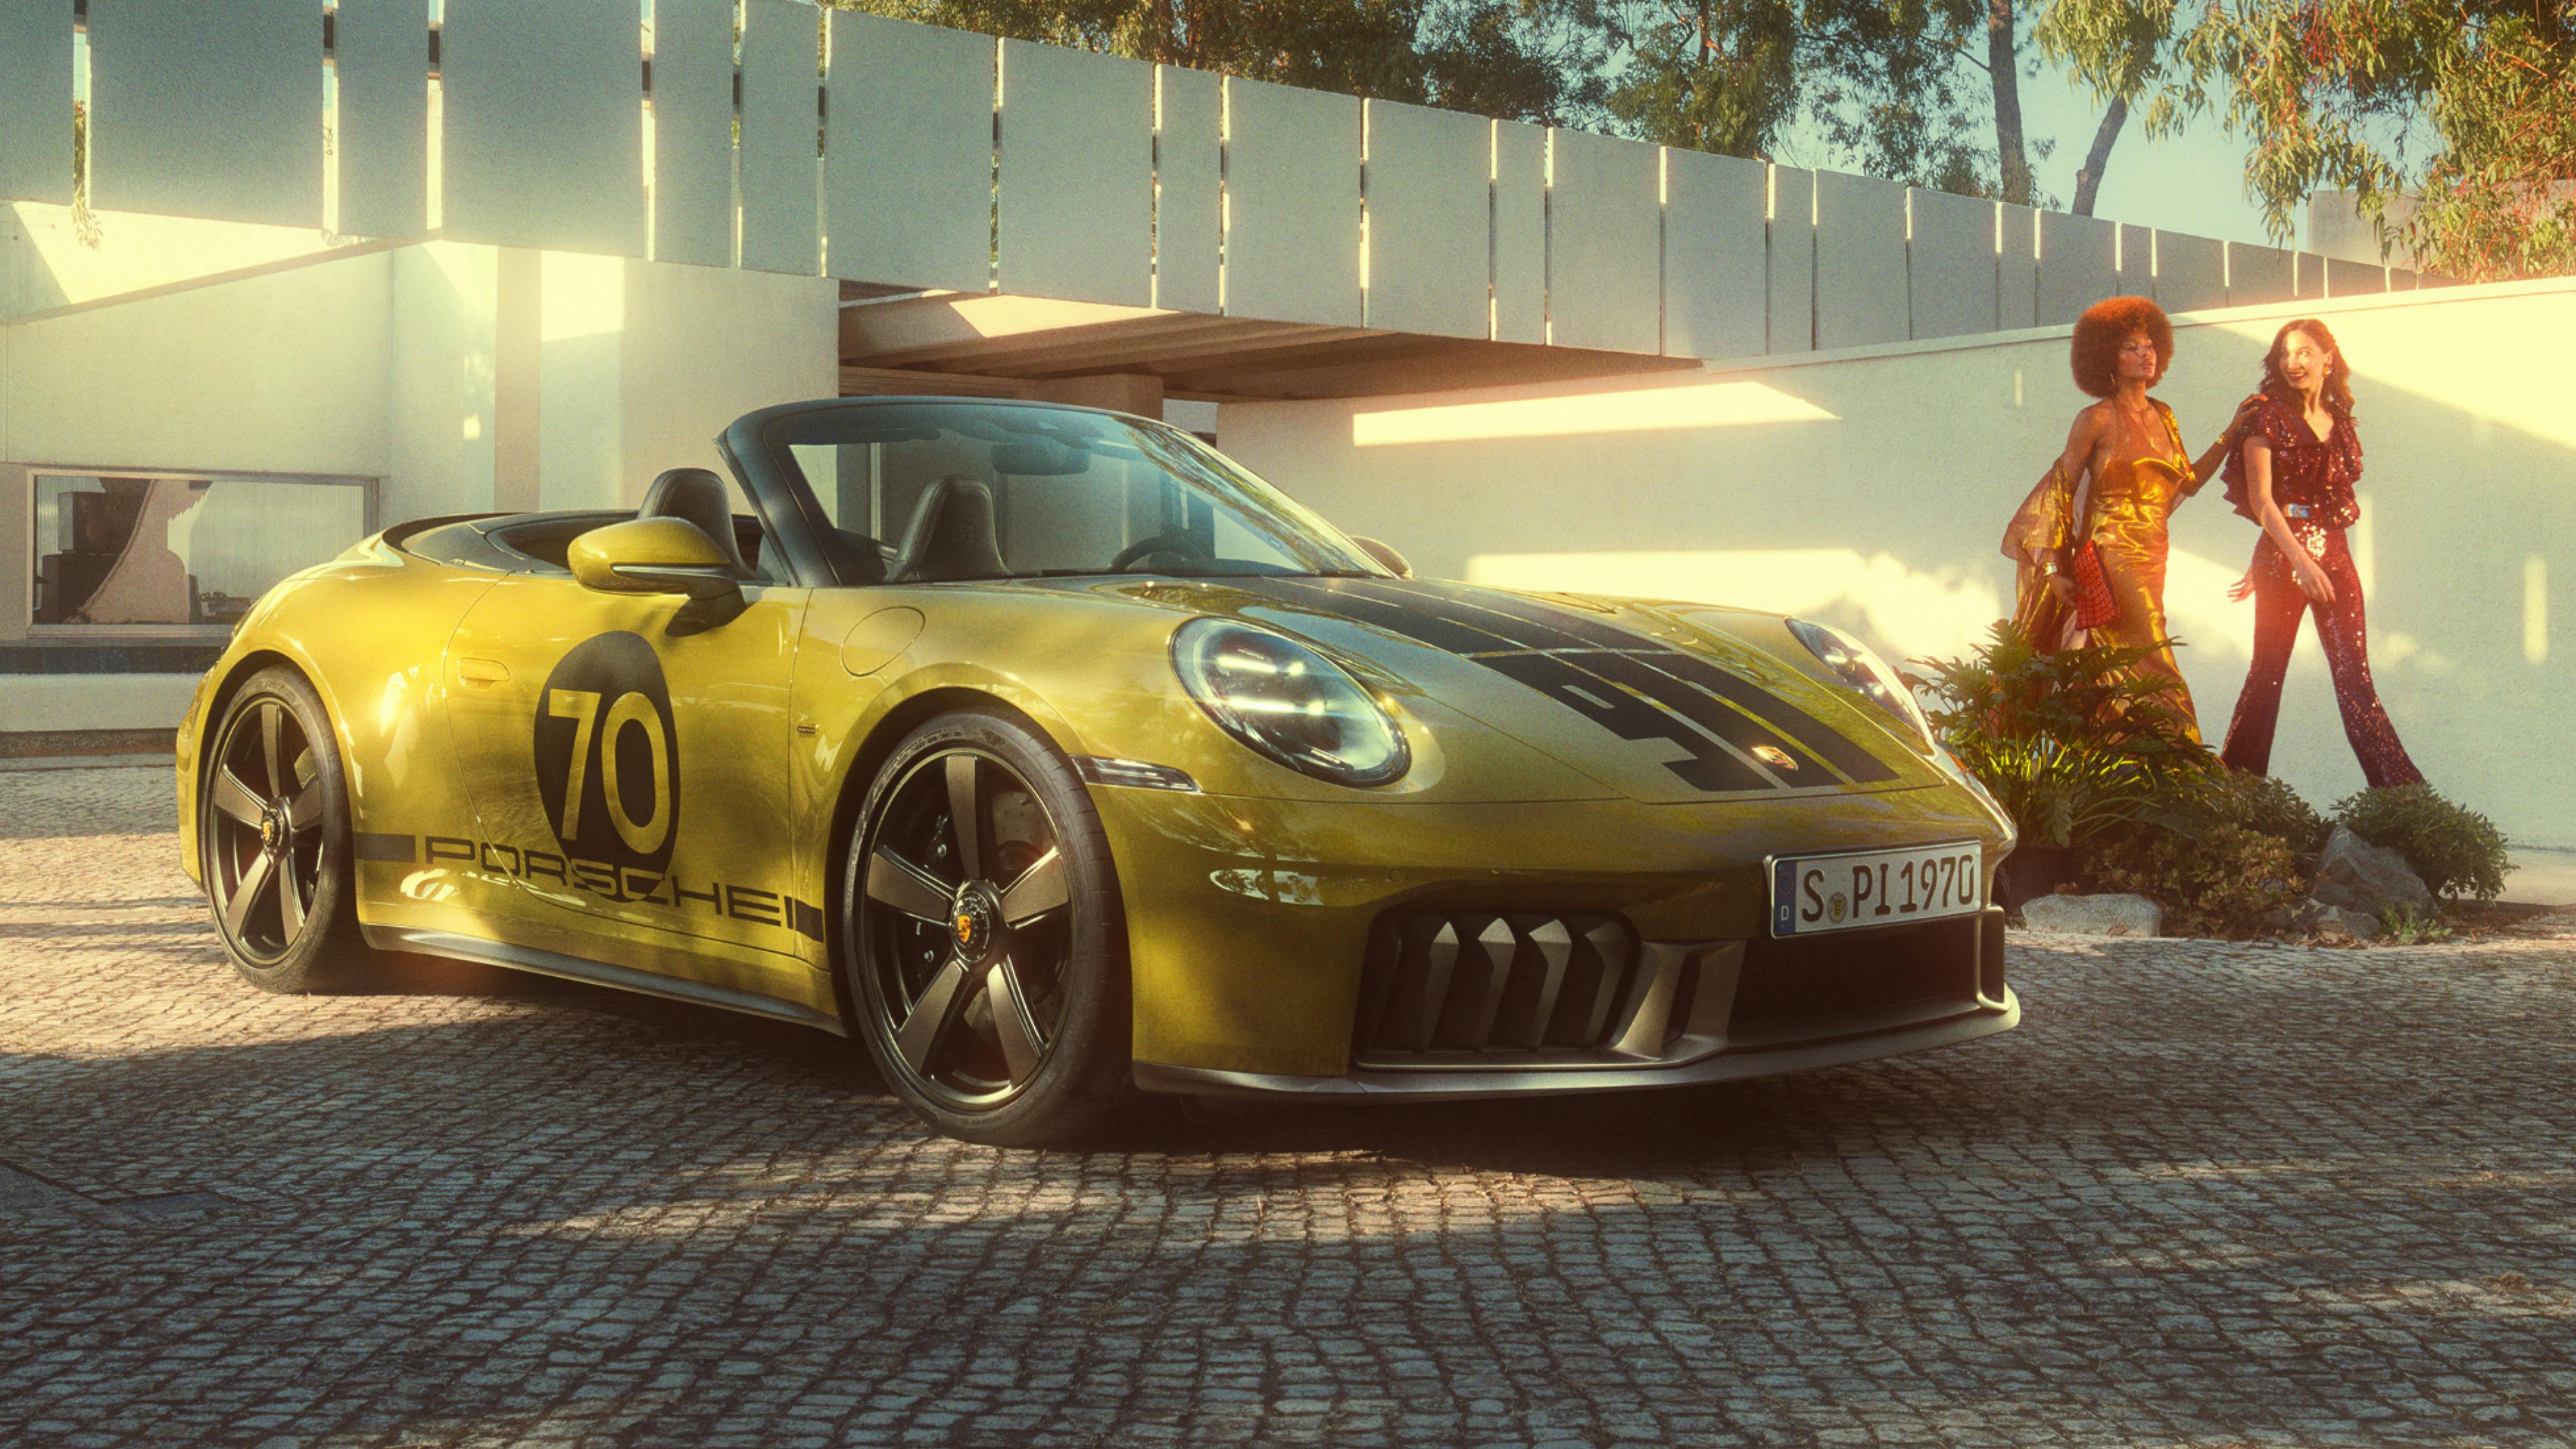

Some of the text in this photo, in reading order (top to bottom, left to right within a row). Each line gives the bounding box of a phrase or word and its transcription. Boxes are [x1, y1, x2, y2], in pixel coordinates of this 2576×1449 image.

[548, 688, 671, 854] 70
[425, 835, 782, 927] PORSCHE
[1780, 905, 1790, 921] D
[1801, 854, 1973, 923] S PI 1970
